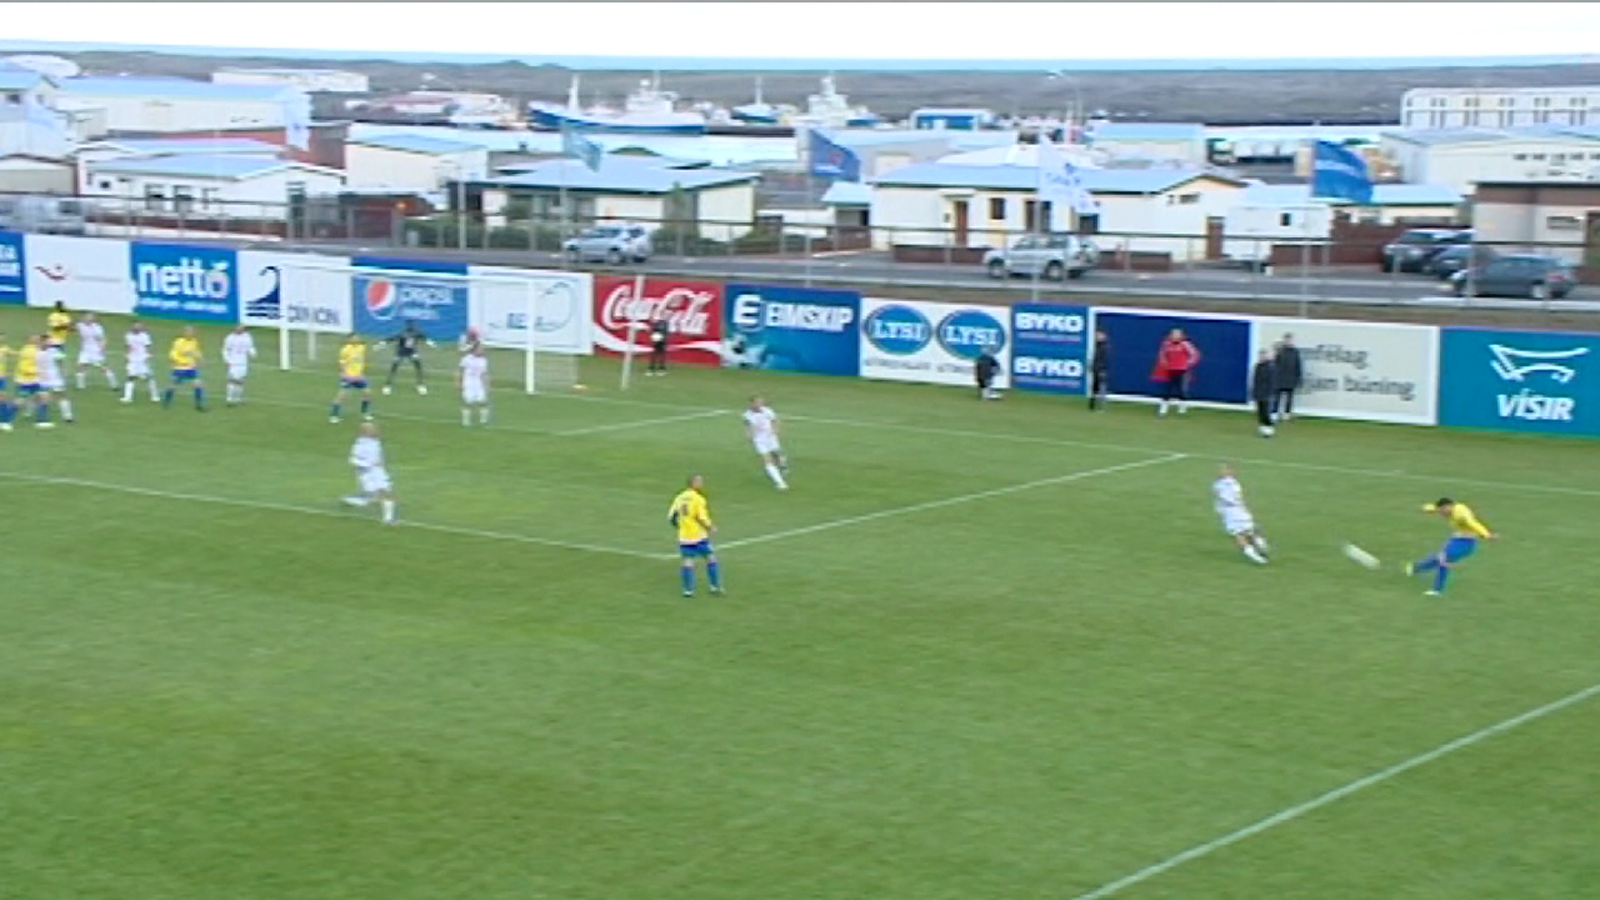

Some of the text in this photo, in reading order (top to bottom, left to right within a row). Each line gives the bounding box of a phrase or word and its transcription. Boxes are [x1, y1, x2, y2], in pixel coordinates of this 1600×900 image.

[766, 303, 854, 332] EIMSKIP
[1014, 312, 1084, 333] BYKO
[1014, 356, 1083, 377] BYKO
